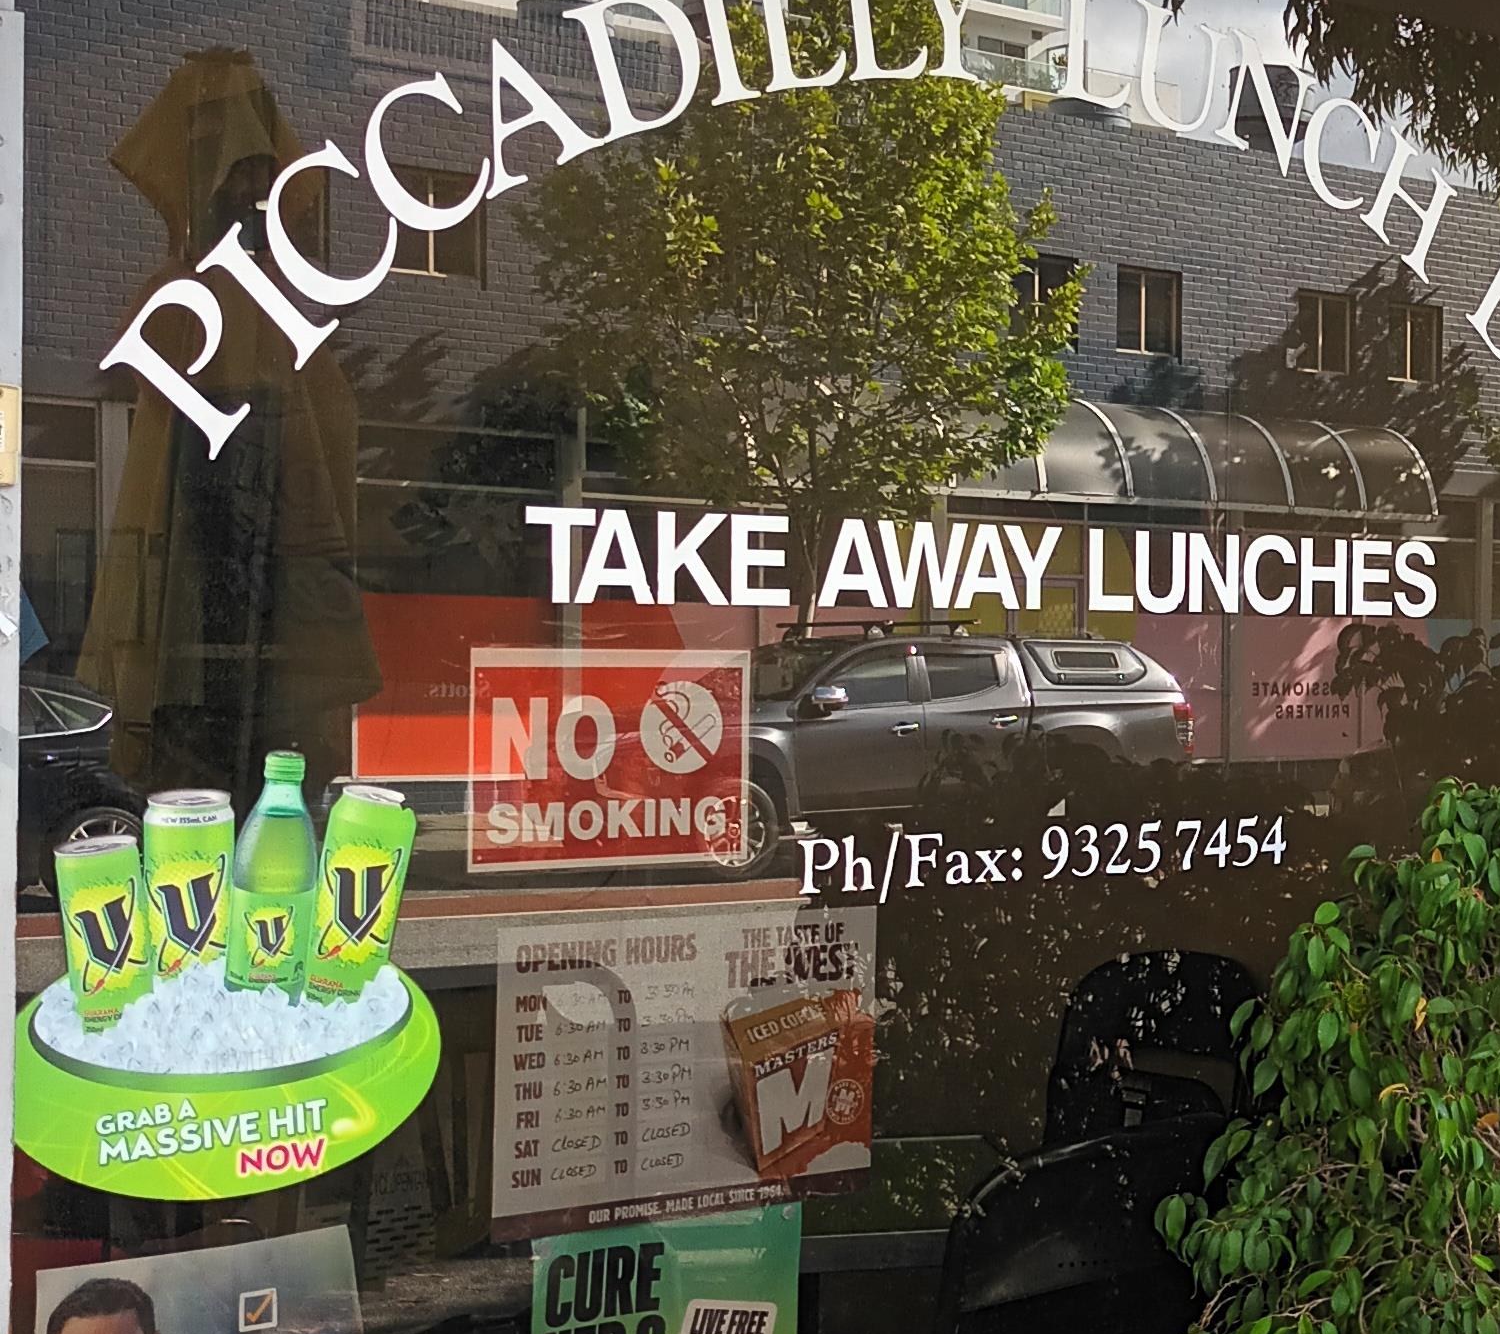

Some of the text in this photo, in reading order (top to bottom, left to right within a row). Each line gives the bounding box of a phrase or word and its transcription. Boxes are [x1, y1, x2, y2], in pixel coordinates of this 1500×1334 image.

[525, 505, 1438, 619] TAKE AWAY LUNCHES
[492, 695, 617, 781] NO
[486, 796, 727, 845] SMOKING
[798, 815, 1288, 904] Ph/Fax: 9325 7454
[154, 871, 216, 955] V
[331, 863, 390, 944] V
[74, 897, 128, 974] V
[255, 912, 288, 956] V
[742, 922, 845, 949] THE TASTE OF
[516, 933, 698, 974] OPENING HOURS
[725, 948, 776, 989] THE
[516, 994, 547, 1013] MON
[617, 989, 631, 1004] TO
[516, 1024, 543, 1043] TUE
[616, 1017, 631, 1032] TO
[746, 1020, 779, 1044] ICED
[513, 1052, 546, 1071] WED
[616, 1045, 630, 1060] TO
[753, 1030, 840, 1078] MASTERS
[514, 1082, 543, 1101] THU
[615, 1074, 630, 1089] TO
[95, 1098, 198, 1136] GRAB A
[615, 1102, 629, 1117] TO
[756, 1046, 834, 1157] M
[98, 1098, 328, 1166] MASSIVE HIT
[516, 1110, 540, 1130] FRI
[614, 1130, 628, 1146] TO
[239, 1138, 326, 1175] NOW
[514, 1138, 540, 1159] SAT
[614, 1159, 628, 1174] TO
[511, 1168, 542, 1189] SUN
[588, 1209, 610, 1224] OUR
[665, 1197, 694, 1213] MADE
[698, 1193, 725, 1209] LOCAL
[728, 1188, 756, 1205] SINCE
[544, 1241, 665, 1329] CURE
